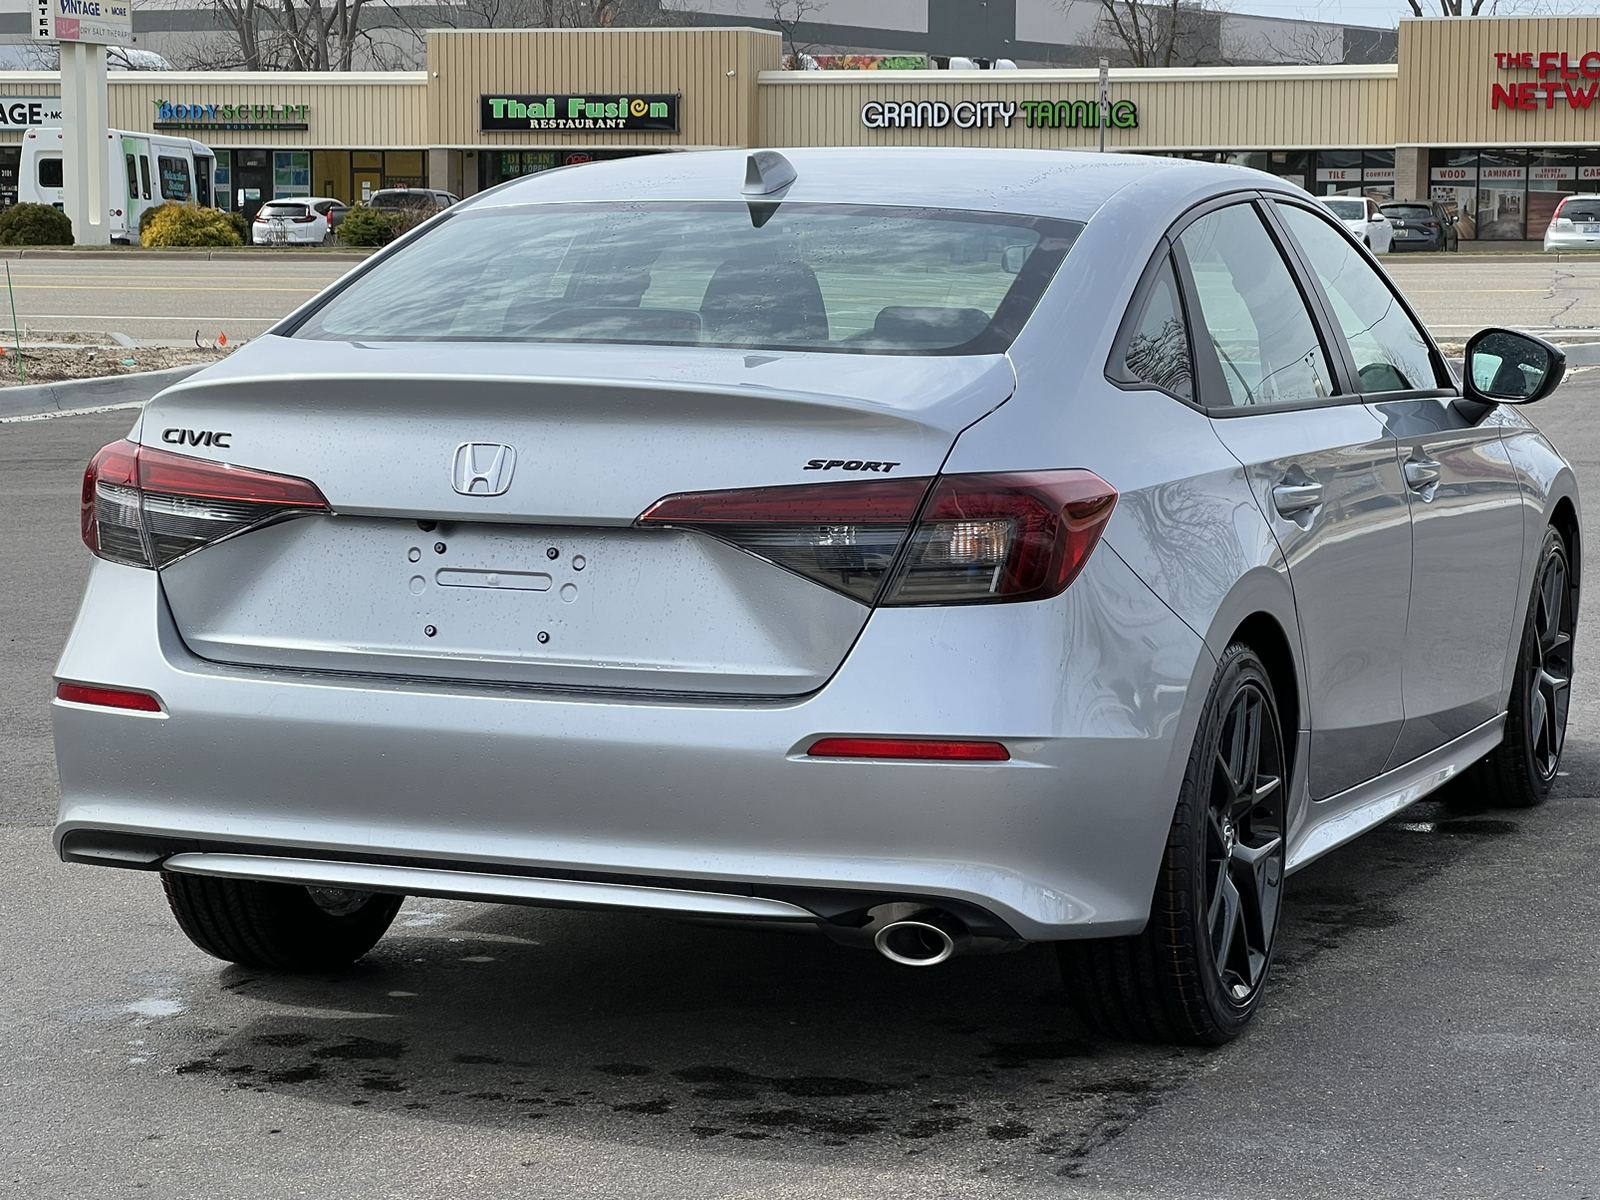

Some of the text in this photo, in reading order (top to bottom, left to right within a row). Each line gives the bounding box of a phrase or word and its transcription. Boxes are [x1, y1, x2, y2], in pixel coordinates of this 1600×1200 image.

[60, 0, 101, 17] VINTAGE
[111, 7, 127, 17] MORE
[80, 26, 91, 35] DRY
[92, 28, 105, 37] SALT
[1494, 52, 1533, 69] THE
[1492, 82, 1600, 111] NETW
[489, 98, 668, 119] Thai Fusion
[861, 101, 951, 129] GRAND
[952, 101, 1016, 129] CITY
[530, 119, 626, 129] RESTAURANT
[1328, 170, 1346, 180] TILE
[1439, 169, 1467, 179] WOOD
[1483, 169, 1522, 178] LAMINATE
[161, 427, 233, 449] CIVIC
[802, 459, 901, 474] SPORT
